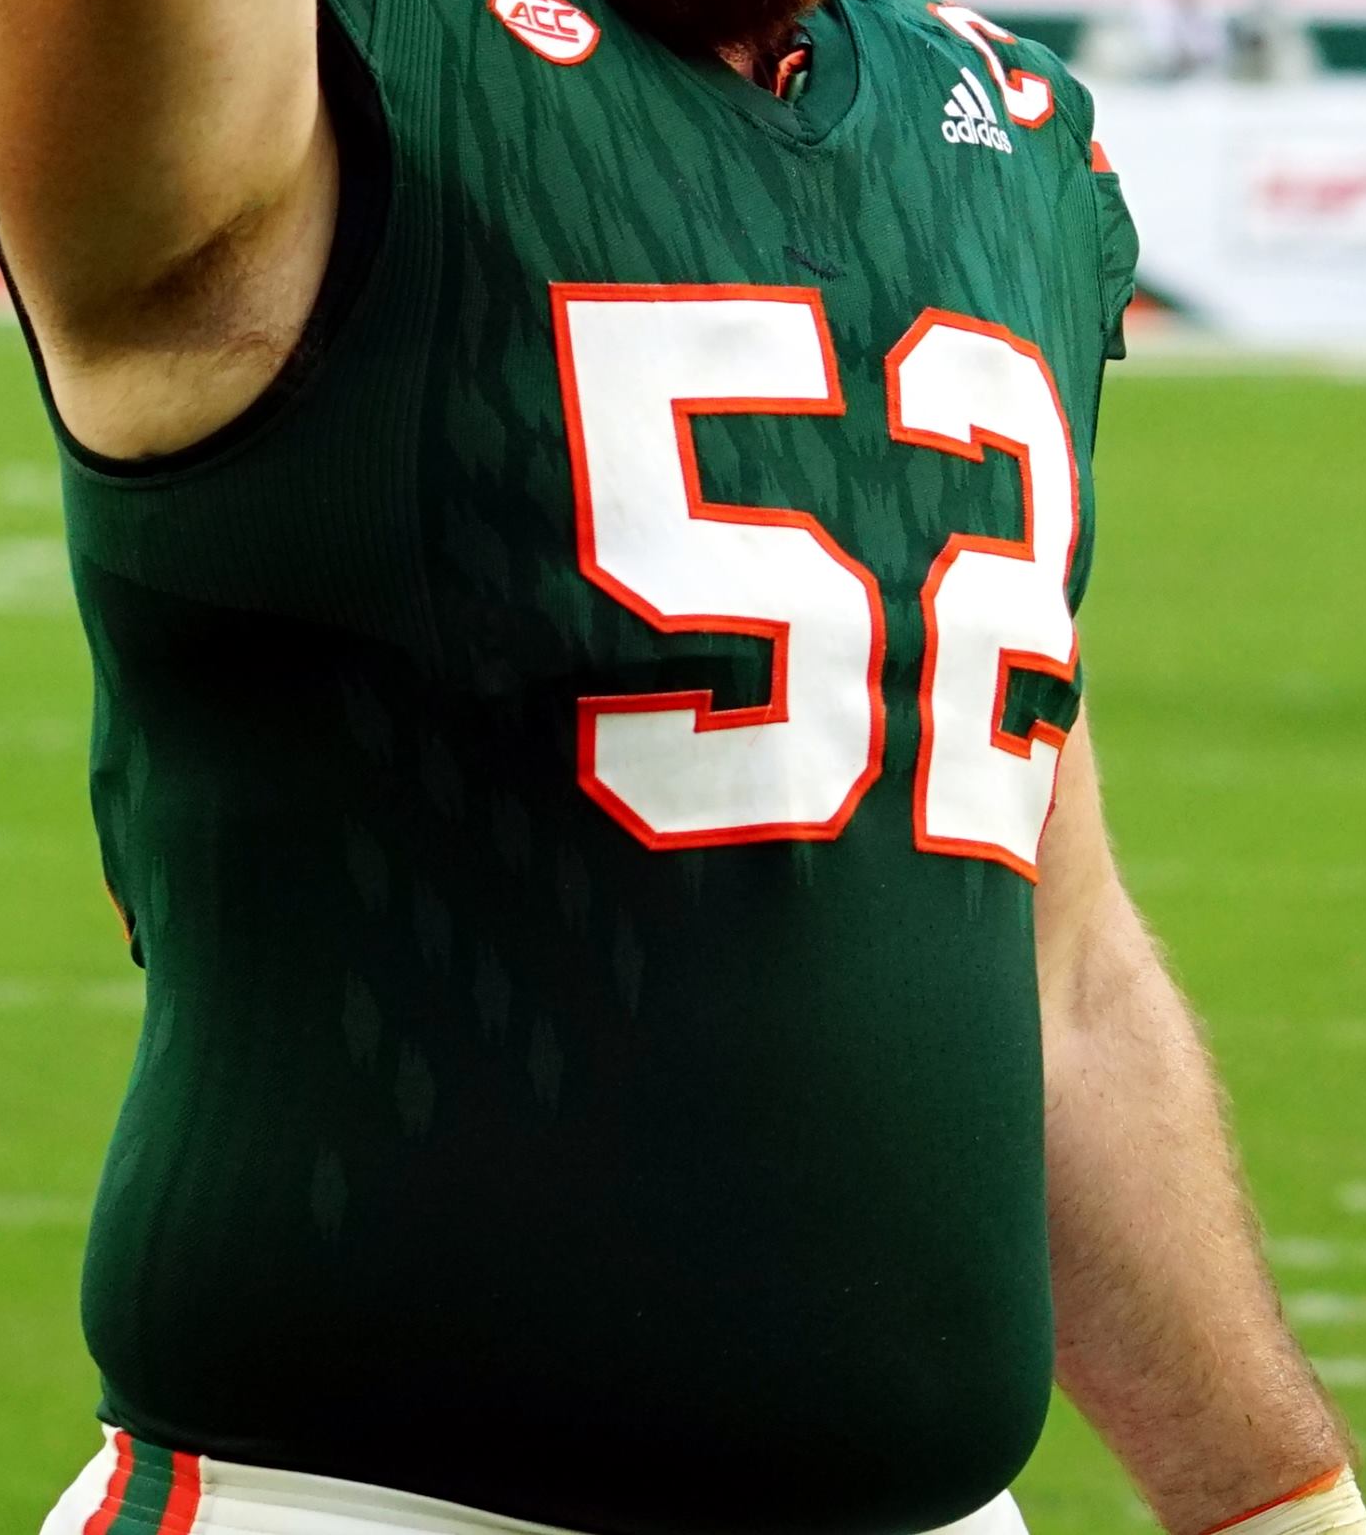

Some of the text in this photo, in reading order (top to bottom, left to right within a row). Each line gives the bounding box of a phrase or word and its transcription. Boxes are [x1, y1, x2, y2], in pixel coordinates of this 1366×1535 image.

[508, 1, 579, 37] ACC
[941, 116, 1013, 155] adidas
[548, 282, 1079, 885] 52
